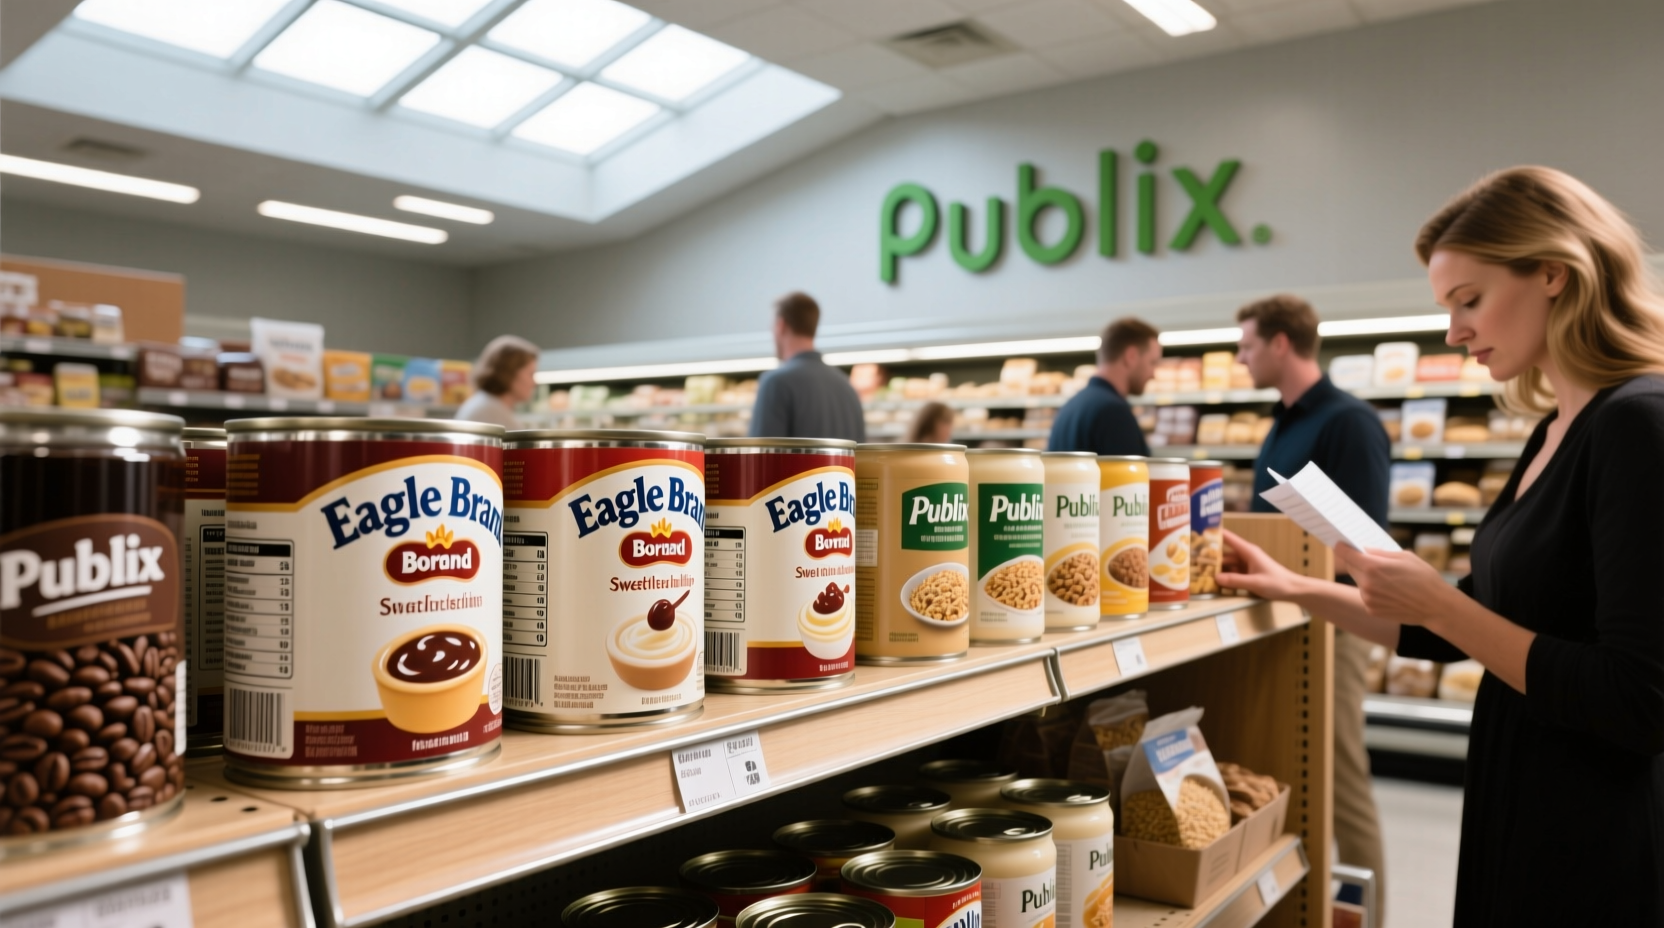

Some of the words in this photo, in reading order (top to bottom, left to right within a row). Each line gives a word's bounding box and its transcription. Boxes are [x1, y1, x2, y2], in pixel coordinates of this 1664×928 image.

[321, 475, 442, 549] Eagle
[448, 476, 503, 548] Bran
[568, 476, 663, 538] Eagle
[765, 481, 836, 533] Eagle
[909, 493, 968, 525] Publix
[0, 533, 165, 610] Publix
